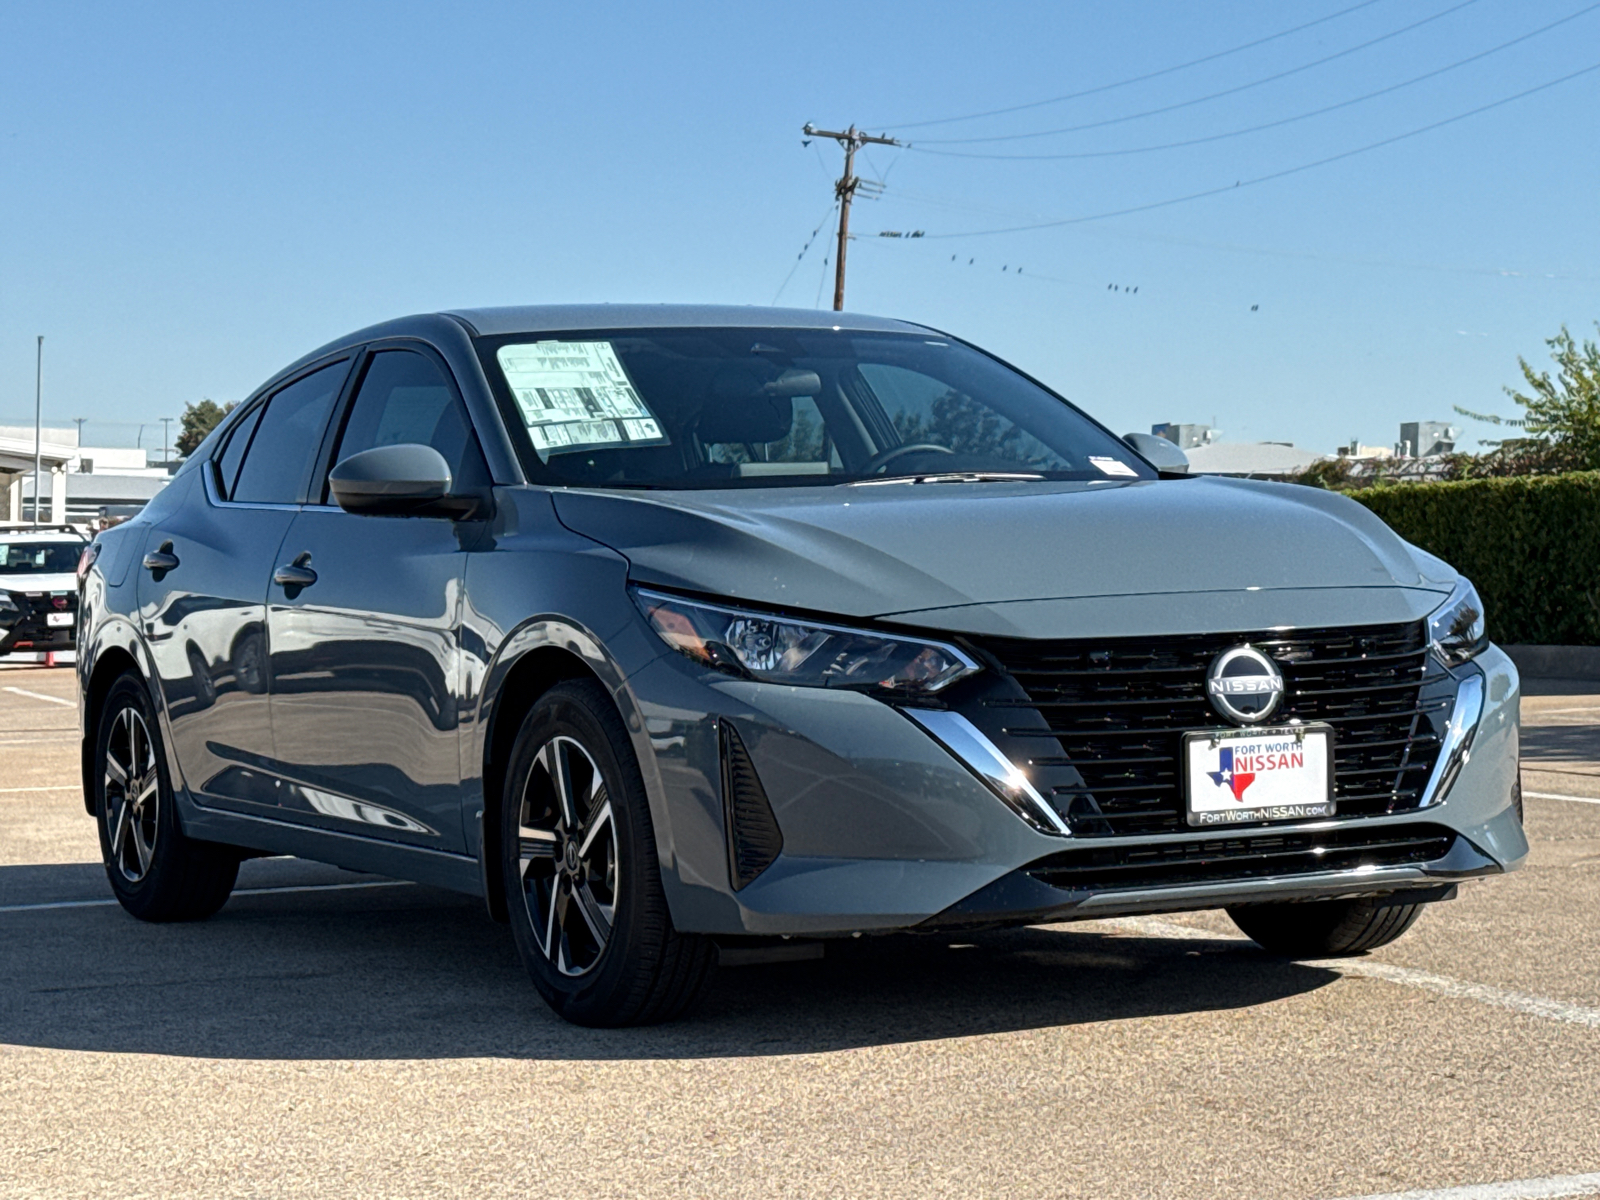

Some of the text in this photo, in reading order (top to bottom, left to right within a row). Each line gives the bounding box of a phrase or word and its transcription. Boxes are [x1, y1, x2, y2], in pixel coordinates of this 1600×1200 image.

[1211, 678, 1282, 693] NISSAN
[1235, 742, 1303, 755] FORT WORTH
[1235, 752, 1304, 772] NISSAN
